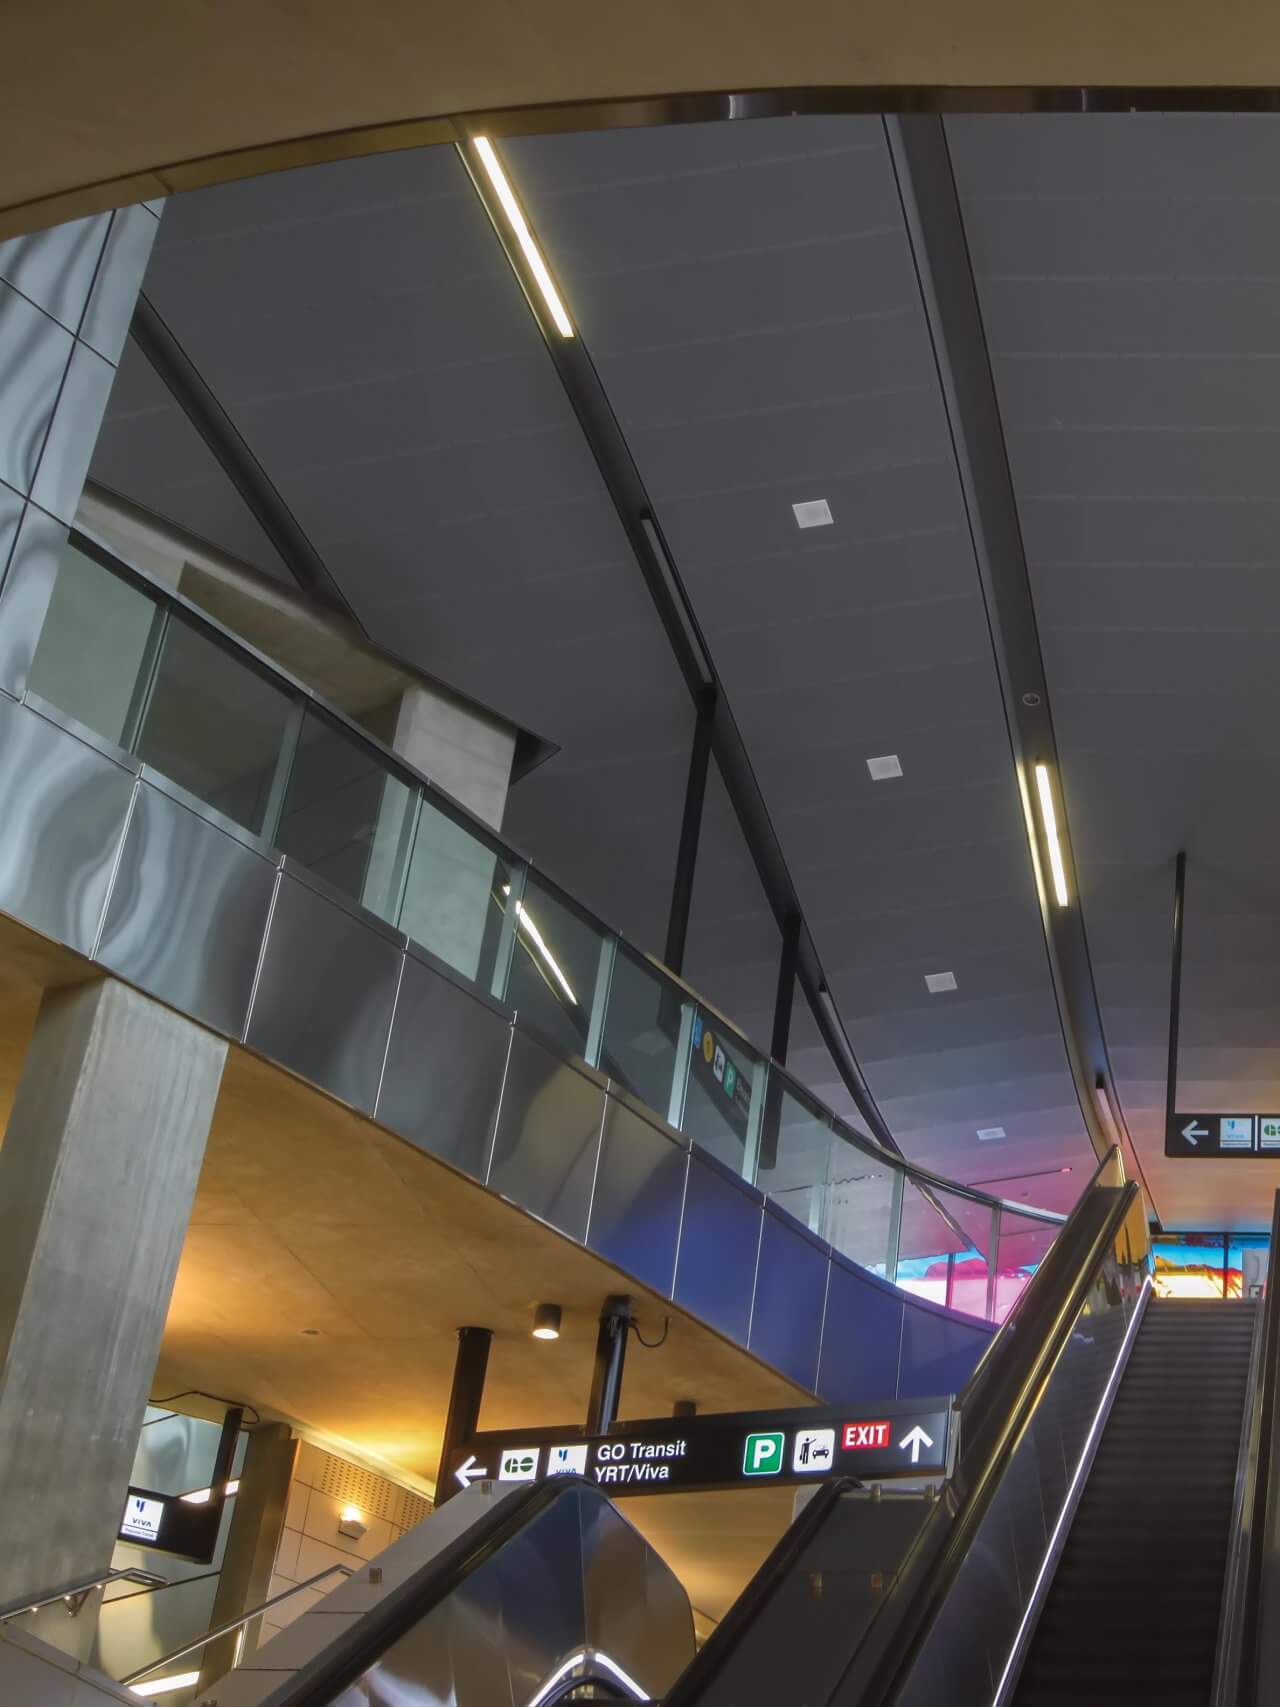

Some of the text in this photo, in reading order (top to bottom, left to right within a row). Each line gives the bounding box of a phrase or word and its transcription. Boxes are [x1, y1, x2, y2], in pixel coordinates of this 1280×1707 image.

[844, 1424, 887, 1447] EXIT
[597, 1439, 687, 1461] GO Transit
[752, 1438, 777, 1470] P
[504, 1456, 534, 1474] GO
[593, 1463, 670, 1483] YRT/Viva
[132, 1518, 152, 1527] VIVA
